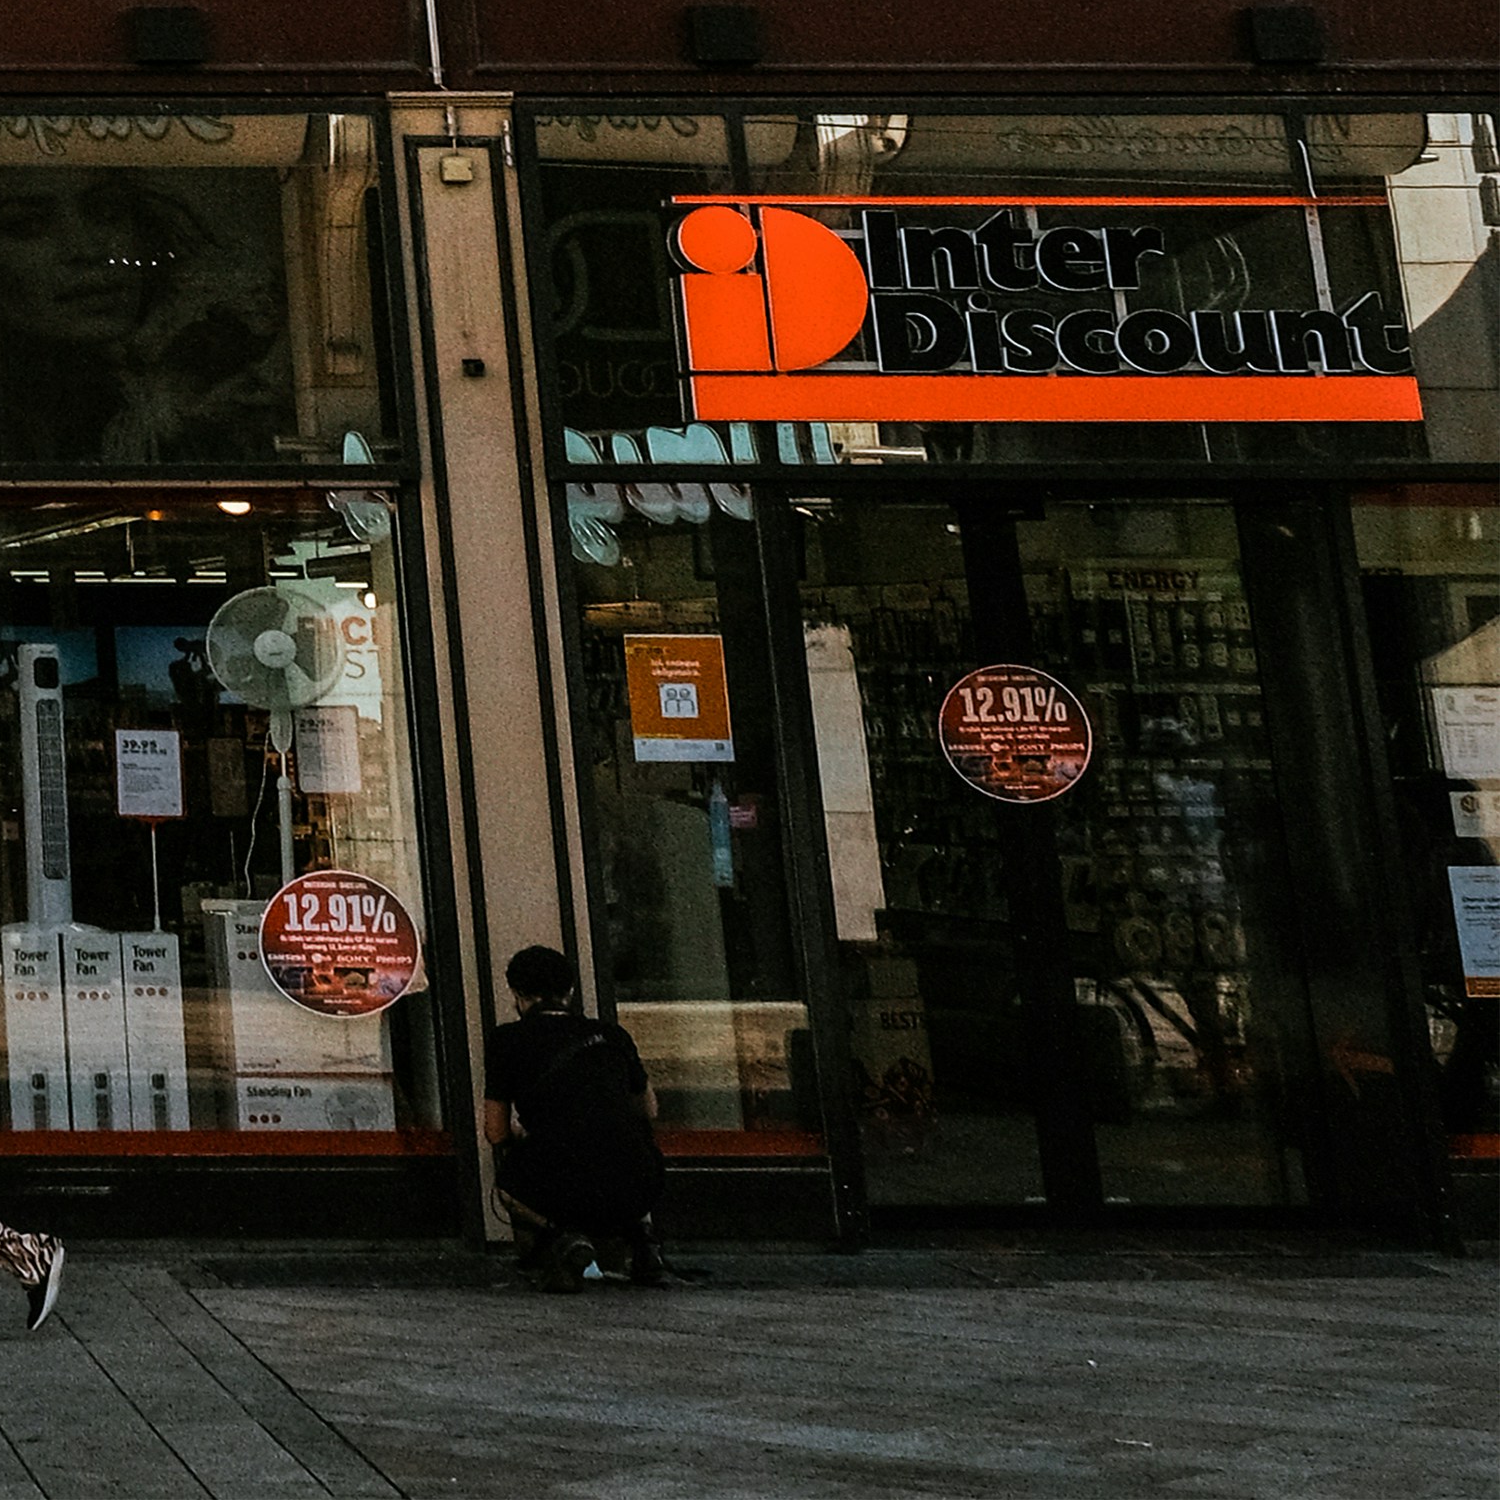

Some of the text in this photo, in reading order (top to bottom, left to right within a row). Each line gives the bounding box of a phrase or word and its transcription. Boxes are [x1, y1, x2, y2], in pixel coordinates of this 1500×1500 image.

[863, 208, 1164, 291] Inter
[873, 290, 1413, 375] Discount
[1107, 569, 1200, 590] ENERGY
[958, 686, 1068, 723] 12.91%
[283, 893, 397, 933] 12.91%
[13, 948, 50, 963] Tower
[74, 948, 110, 963] Tower
[131, 945, 168, 960] Tower
[14, 962, 36, 976] Fan
[75, 962, 98, 976] Fan
[132, 959, 155, 973] Fan
[246, 1085, 312, 1100] Standing Fan
